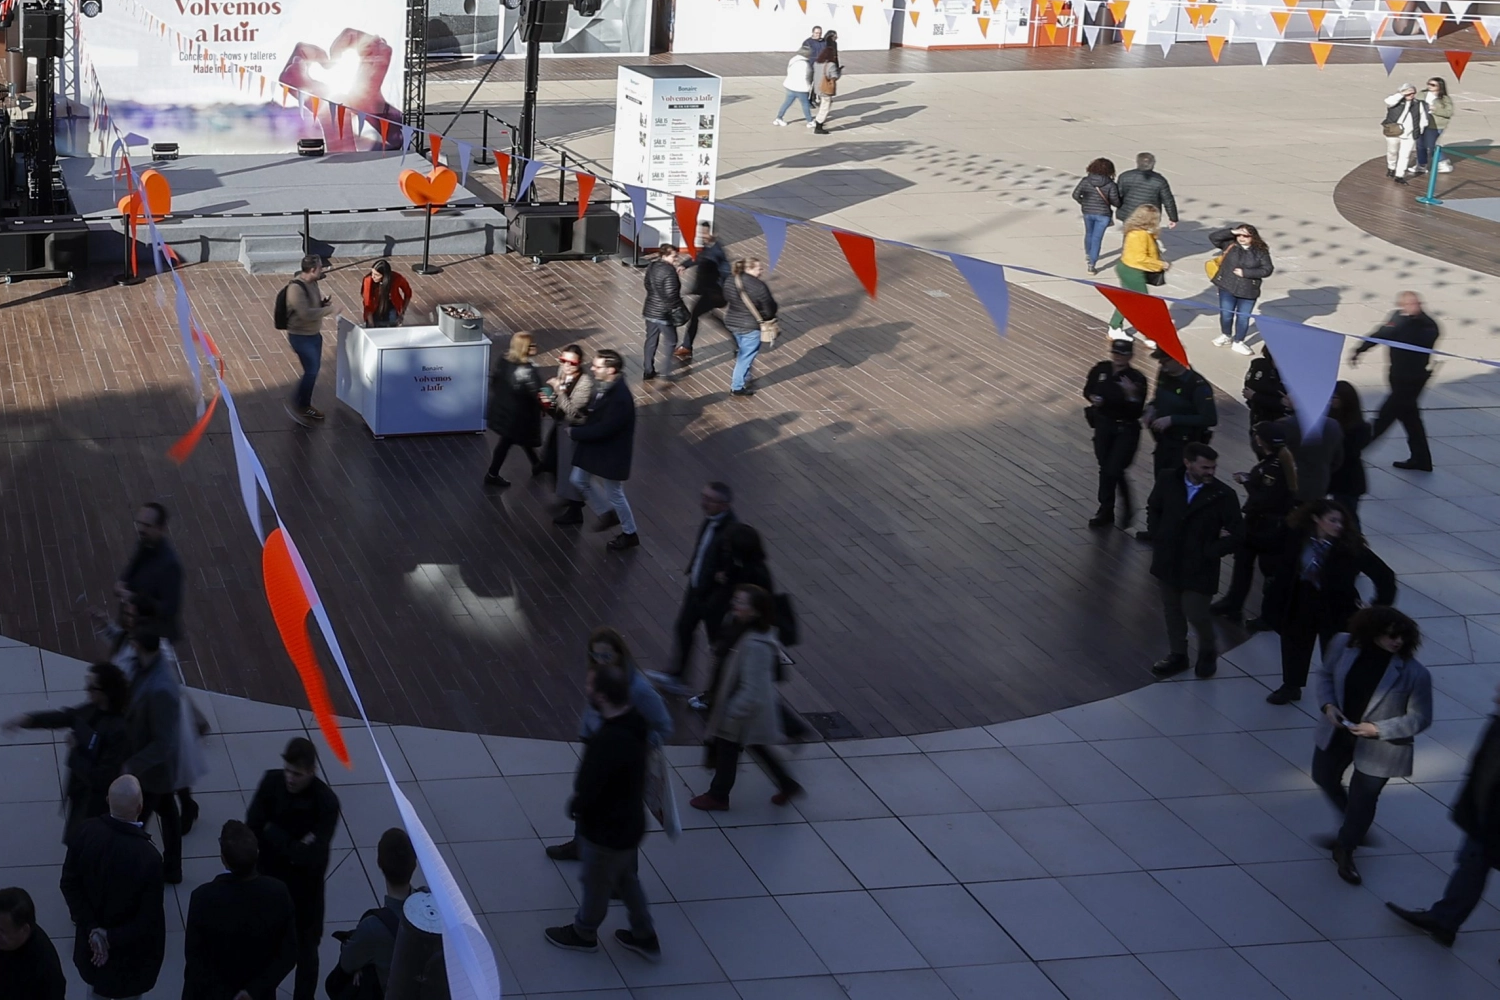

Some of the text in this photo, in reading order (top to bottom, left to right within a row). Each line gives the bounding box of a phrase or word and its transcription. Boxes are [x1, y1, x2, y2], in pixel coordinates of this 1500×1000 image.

[195, 21, 259, 42] a latir
[250, 51, 276, 60] talleres
